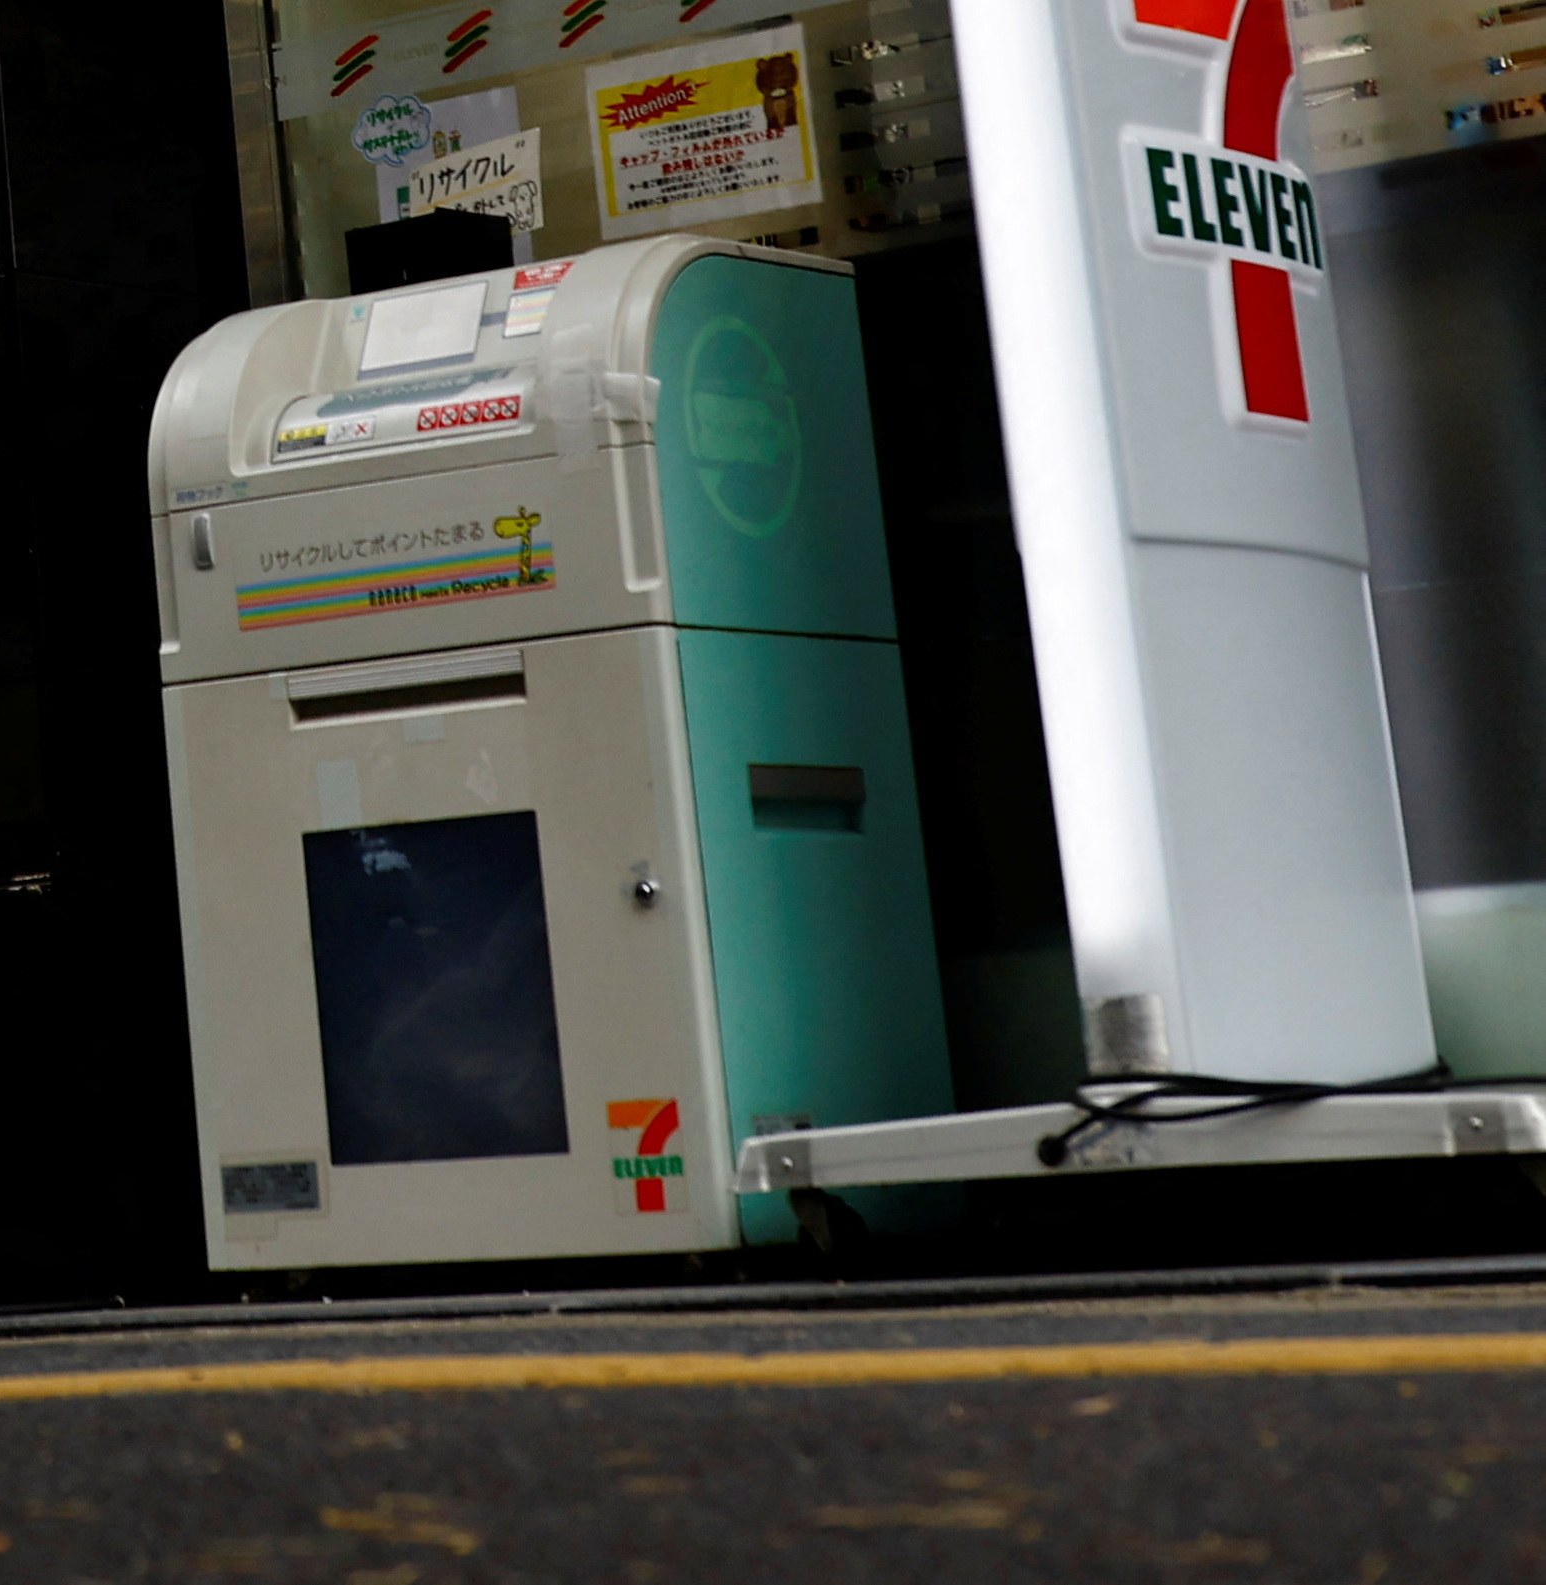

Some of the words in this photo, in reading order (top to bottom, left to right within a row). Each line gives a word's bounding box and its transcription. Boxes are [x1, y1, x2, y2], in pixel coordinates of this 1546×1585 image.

[259, 519, 485, 573] リサイクルしてポイントたまる
[451, 575, 510, 600] Recycle
